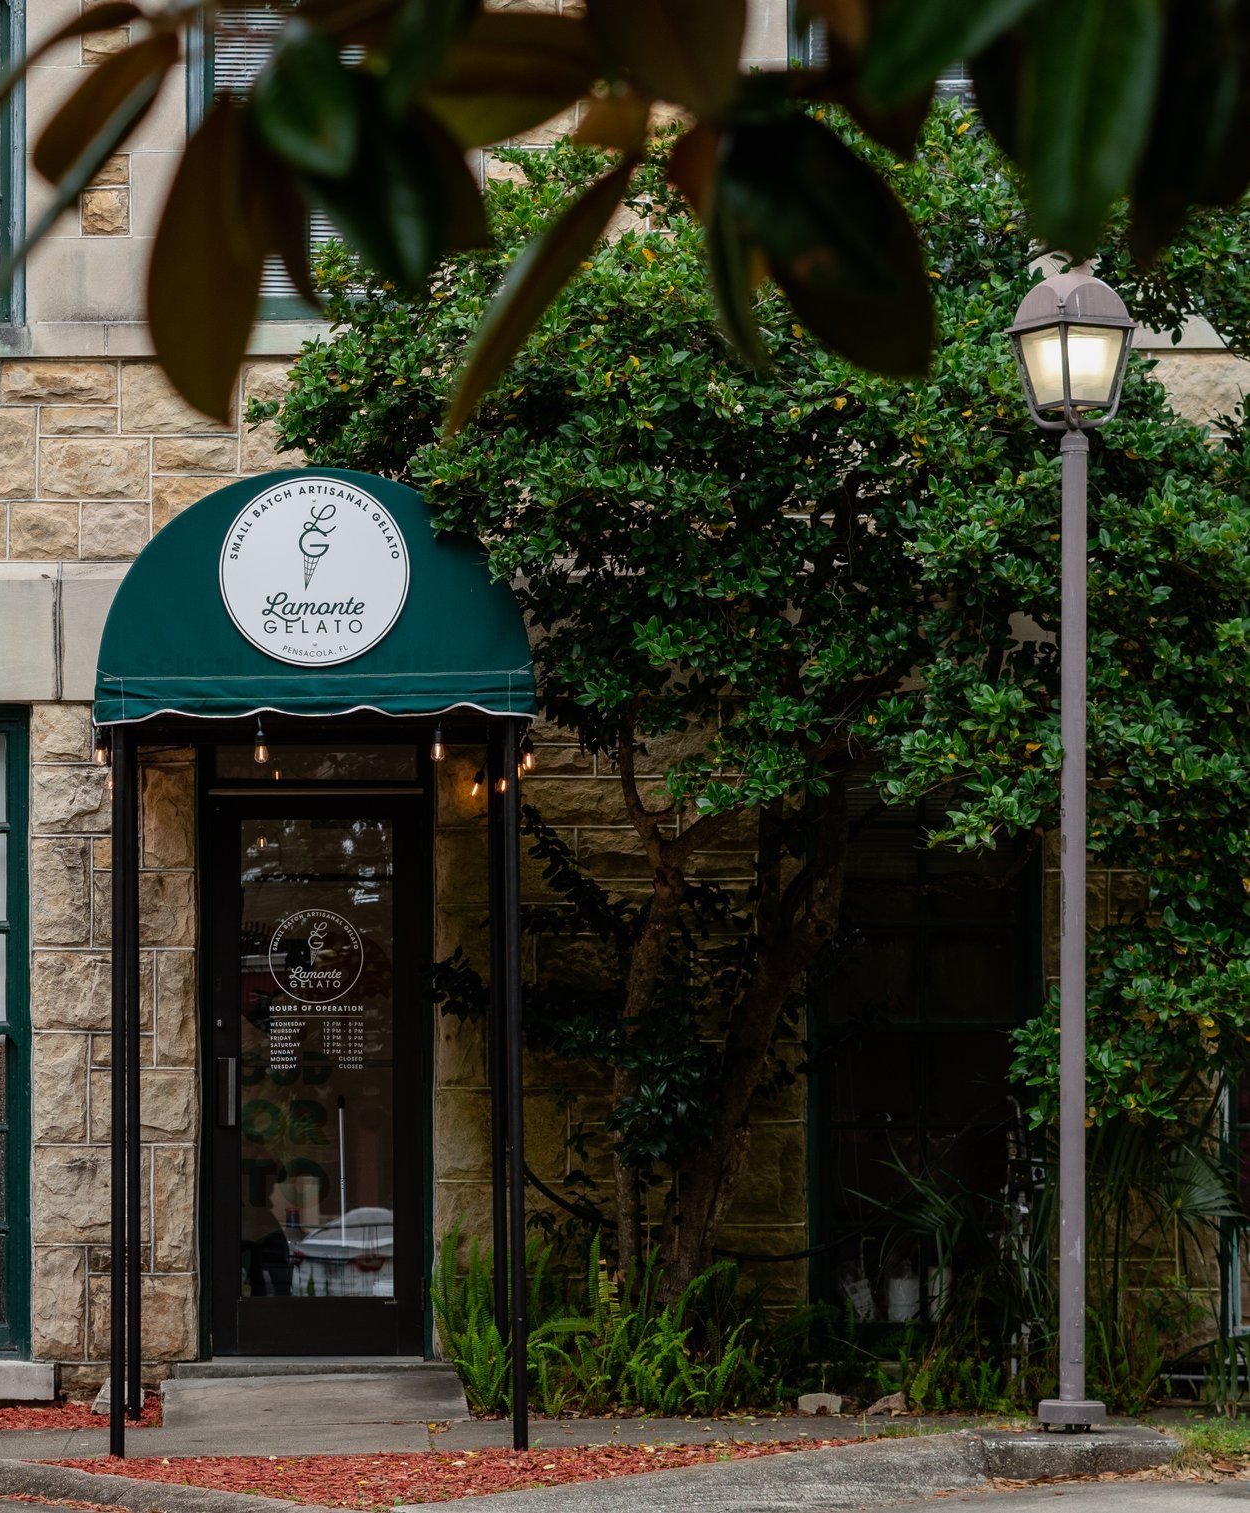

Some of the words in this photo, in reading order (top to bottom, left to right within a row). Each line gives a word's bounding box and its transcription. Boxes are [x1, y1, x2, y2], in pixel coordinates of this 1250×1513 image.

[229, 520, 253, 561] SMALL
[252, 489, 293, 519] BATCH
[298, 485, 370, 513] ARTISANAL
[371, 512, 401, 560] GELATO
[261, 591, 366, 623] Lamonte
[263, 619, 363, 634] GELATO
[282, 645, 337, 658] PENSACOLA,
[272, 930, 285, 951] SMALL
[283, 914, 304, 930] BATCH
[306, 912, 343, 926] ARTISANAL
[343, 925, 359, 950] GELATO
[289, 966, 342, 982] Lamonte
[289, 980, 341, 988] GELATO
